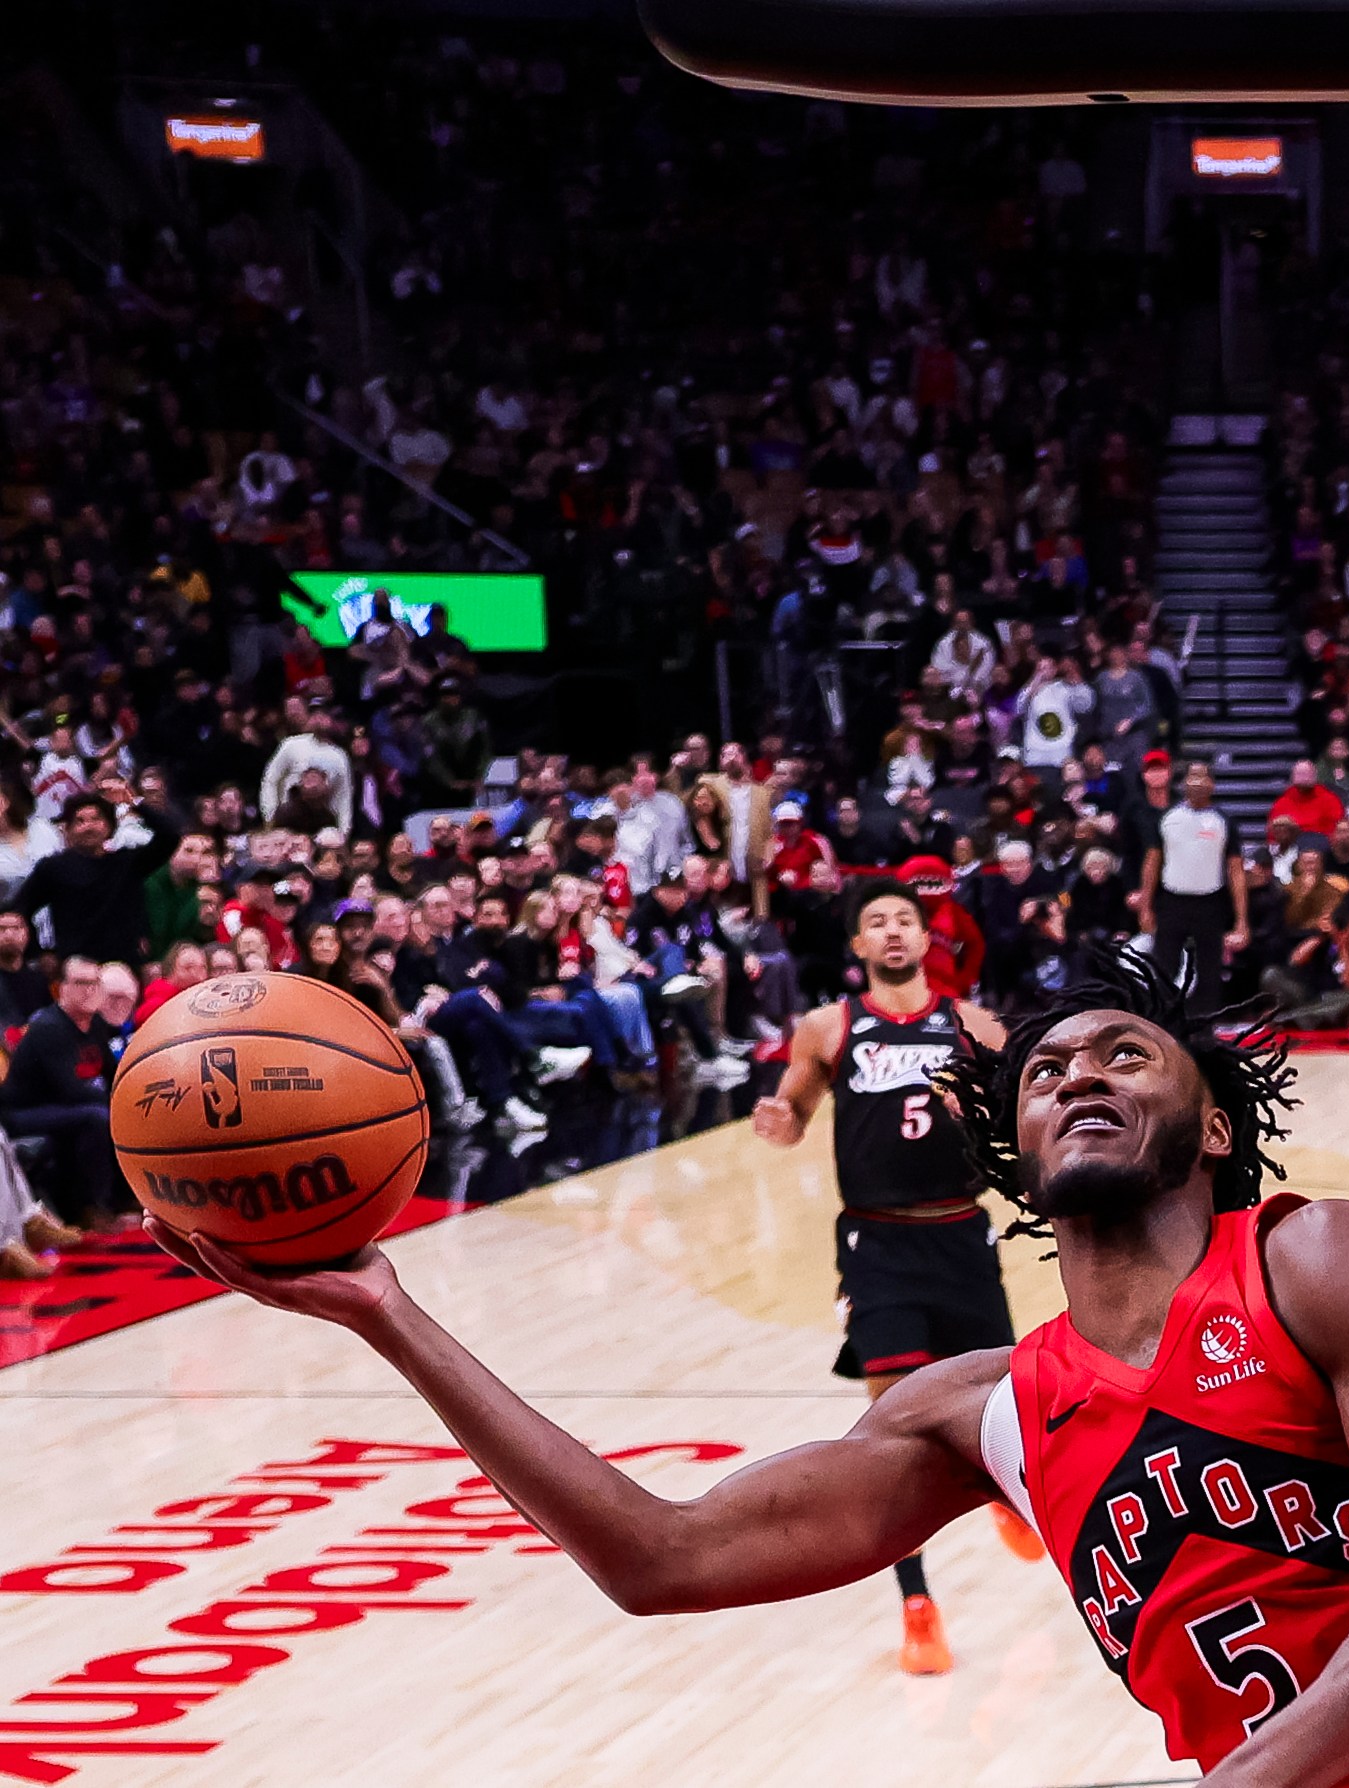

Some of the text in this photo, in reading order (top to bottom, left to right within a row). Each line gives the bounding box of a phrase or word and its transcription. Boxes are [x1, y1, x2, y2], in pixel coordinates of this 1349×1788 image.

[901, 1094, 933, 1140] 5
[142, 1154, 357, 1222] Wilson
[1196, 1356, 1266, 1392] Sun Life
[0, 1441, 746, 1786] Sotiabank
[1185, 1596, 1302, 1738] 5
